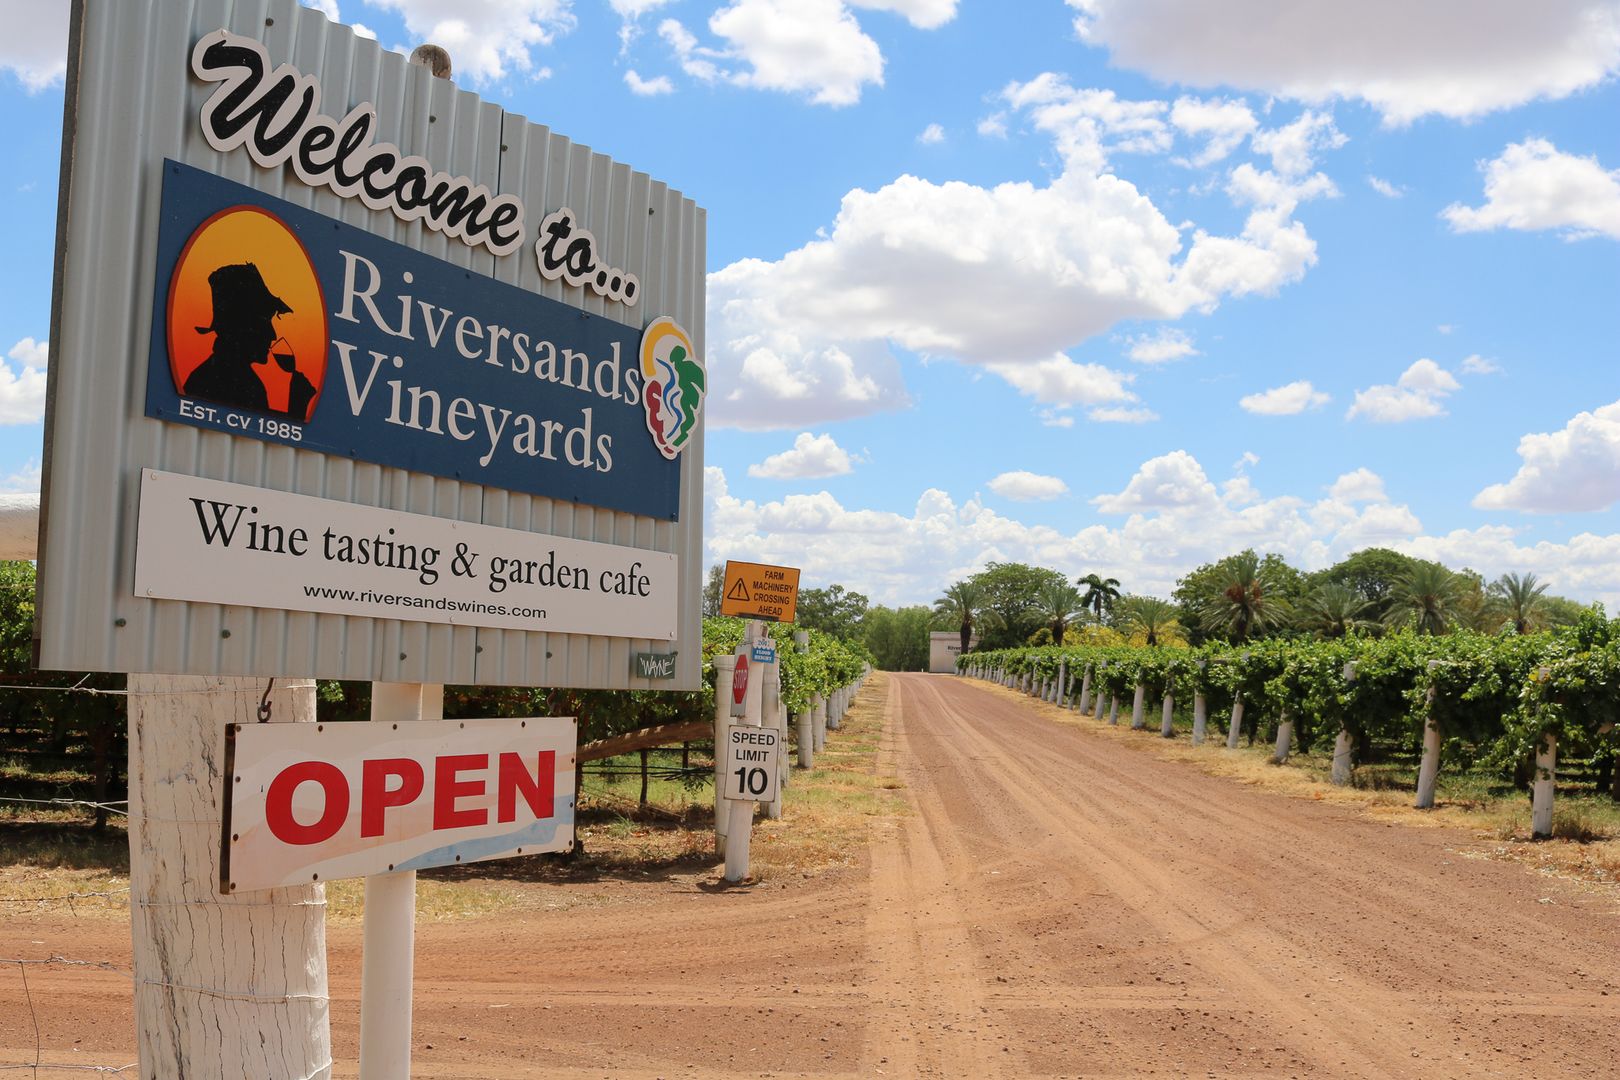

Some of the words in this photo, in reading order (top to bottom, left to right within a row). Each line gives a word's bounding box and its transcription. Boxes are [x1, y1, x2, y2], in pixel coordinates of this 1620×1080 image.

[200, 38, 521, 248] Welcome
[334, 249, 640, 406] Riversands
[331, 339, 613, 473] Vineyards
[258, 417, 303, 442] 1985
[188, 496, 308, 556] Wine
[322, 528, 441, 585] tasting
[450, 541, 478, 578] &
[489, 550, 590, 592] garden
[598, 561, 652, 597] cafe
[752, 581, 794, 594] MACHINERY
[764, 570, 785, 581] FARM
[303, 584, 547, 619] www.riversandswines.com
[753, 592, 790, 605] CROSSING
[757, 605, 783, 616] AHEAD
[733, 669, 748, 689] STOP
[732, 731, 776, 746] SPEED
[735, 749, 770, 762] LIMIT
[734, 766, 768, 795] 10
[264, 750, 556, 846] OPEN
